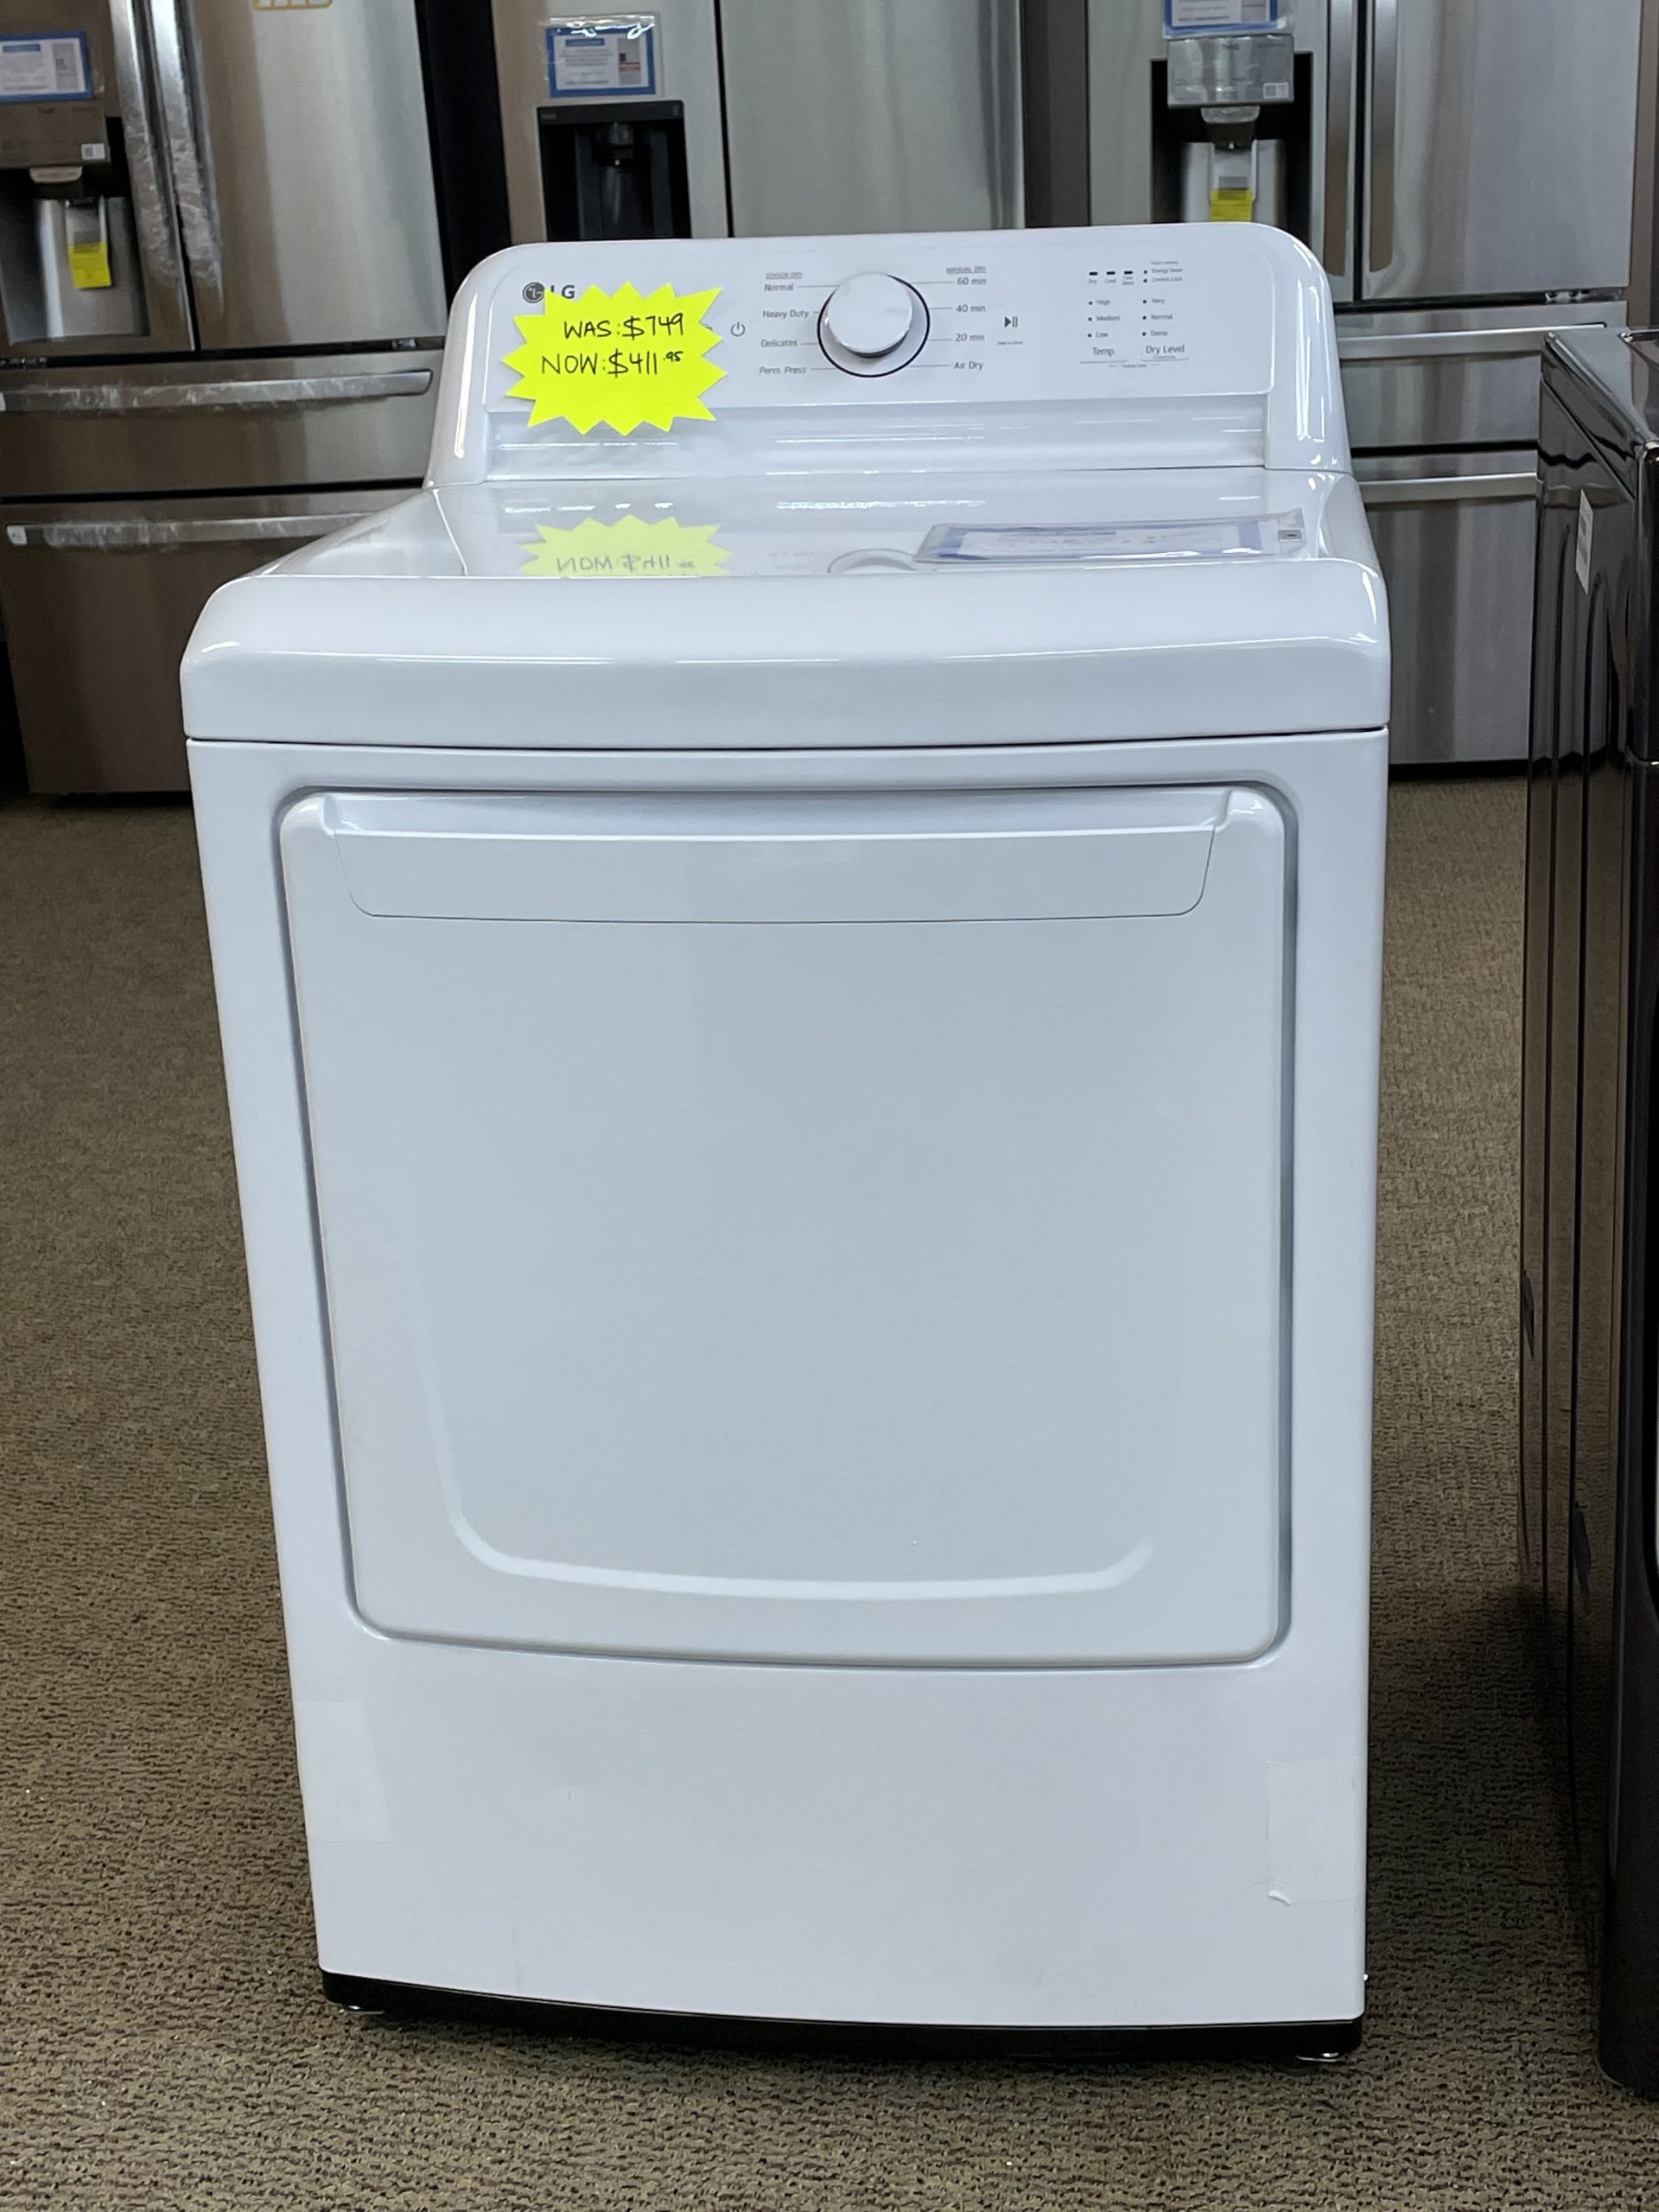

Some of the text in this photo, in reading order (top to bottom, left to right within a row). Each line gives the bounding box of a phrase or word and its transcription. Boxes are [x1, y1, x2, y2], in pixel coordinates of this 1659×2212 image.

[956, 304, 968, 313] 40
[762, 309, 809, 319] Heavy Duty
[955, 333, 967, 342] 20
[761, 339, 798, 347] Delicates
[1093, 347, 1115, 357] Temp
[1146, 345, 1185, 354] Dry Level
[969, 361, 983, 371] Dry
